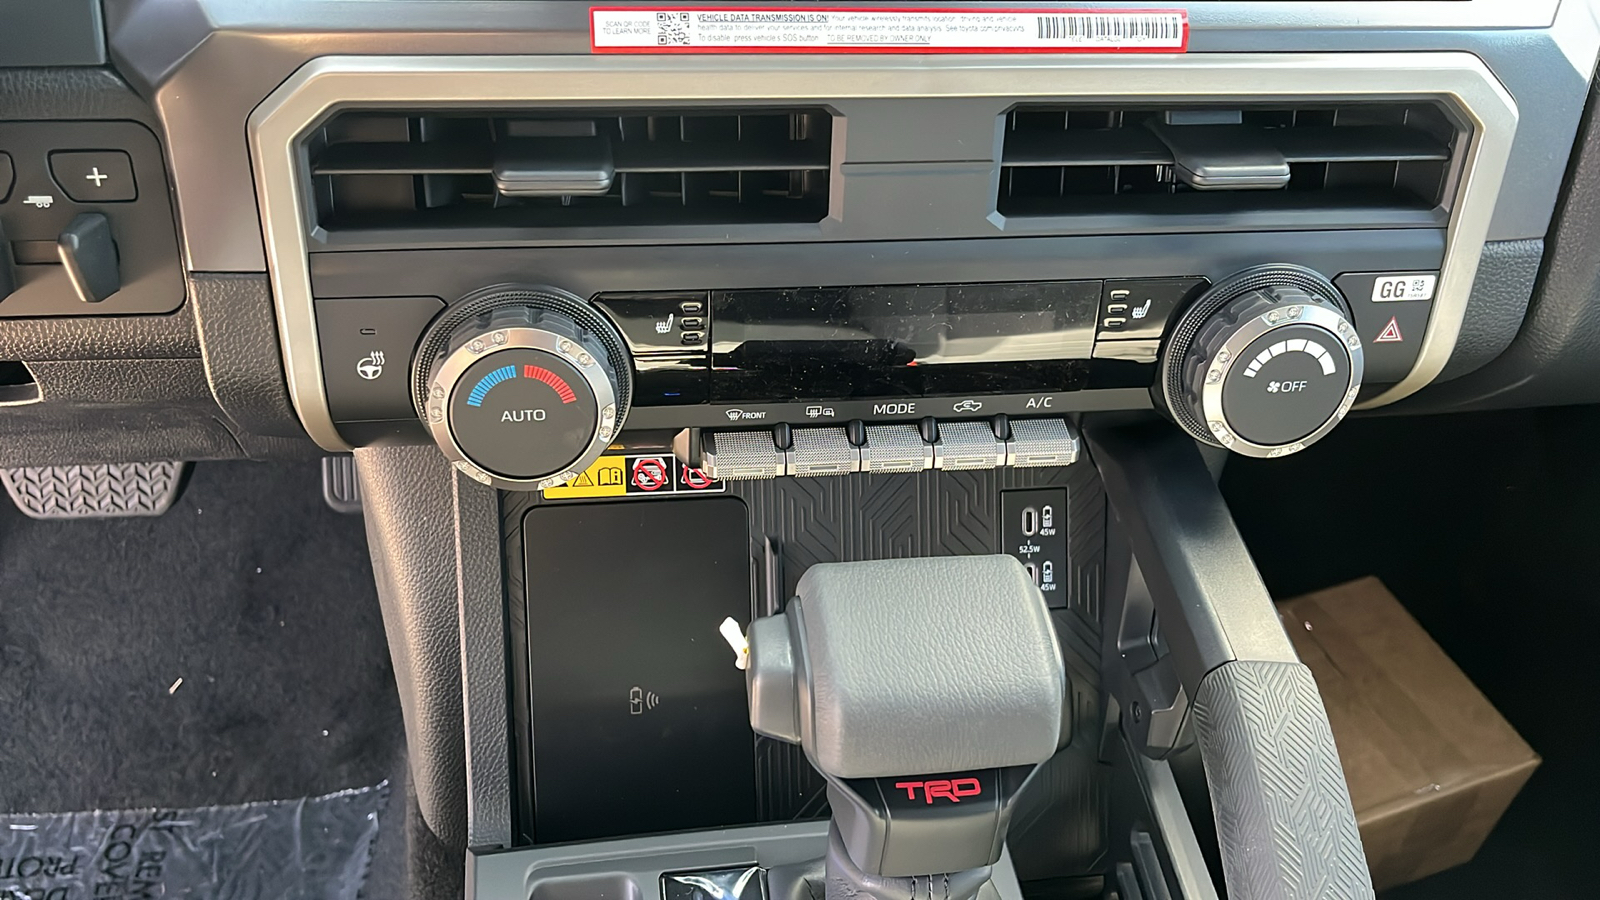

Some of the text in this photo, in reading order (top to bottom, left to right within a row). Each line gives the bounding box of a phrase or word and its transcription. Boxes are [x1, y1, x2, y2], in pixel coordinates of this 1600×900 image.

[696, 13, 728, 22] VEHICLE
[730, 13, 750, 22] DATA
[751, 13, 806, 22] TRANSMISSION
[807, 13, 815, 22] IS
[605, 20, 651, 28] SCAN QR CODE
[602, 27, 652, 35] TO LEARN MORE
[697, 32, 706, 42] To
[734, 35, 752, 43] press
[782, 33, 798, 42] SOS
[826, 34, 836, 42] TO
[836, 34, 845, 42] BE
[846, 34, 879, 42] REMOVED
[879, 34, 889, 42] BY
[890, 34, 914, 43] OWNER
[915, 34, 932, 43] ONLY
[1380, 281, 1406, 298] GG
[1281, 381, 1307, 392] OFF
[1026, 397, 1053, 409] A/C
[873, 403, 915, 415] MODE
[501, 409, 546, 422] AUTO
[742, 411, 767, 419] FRONT
[1040, 528, 1056, 536] 45W
[1019, 545, 1041, 553] 52.5W
[1040, 583, 1057, 591] 45W
[895, 778, 982, 804] TRD
